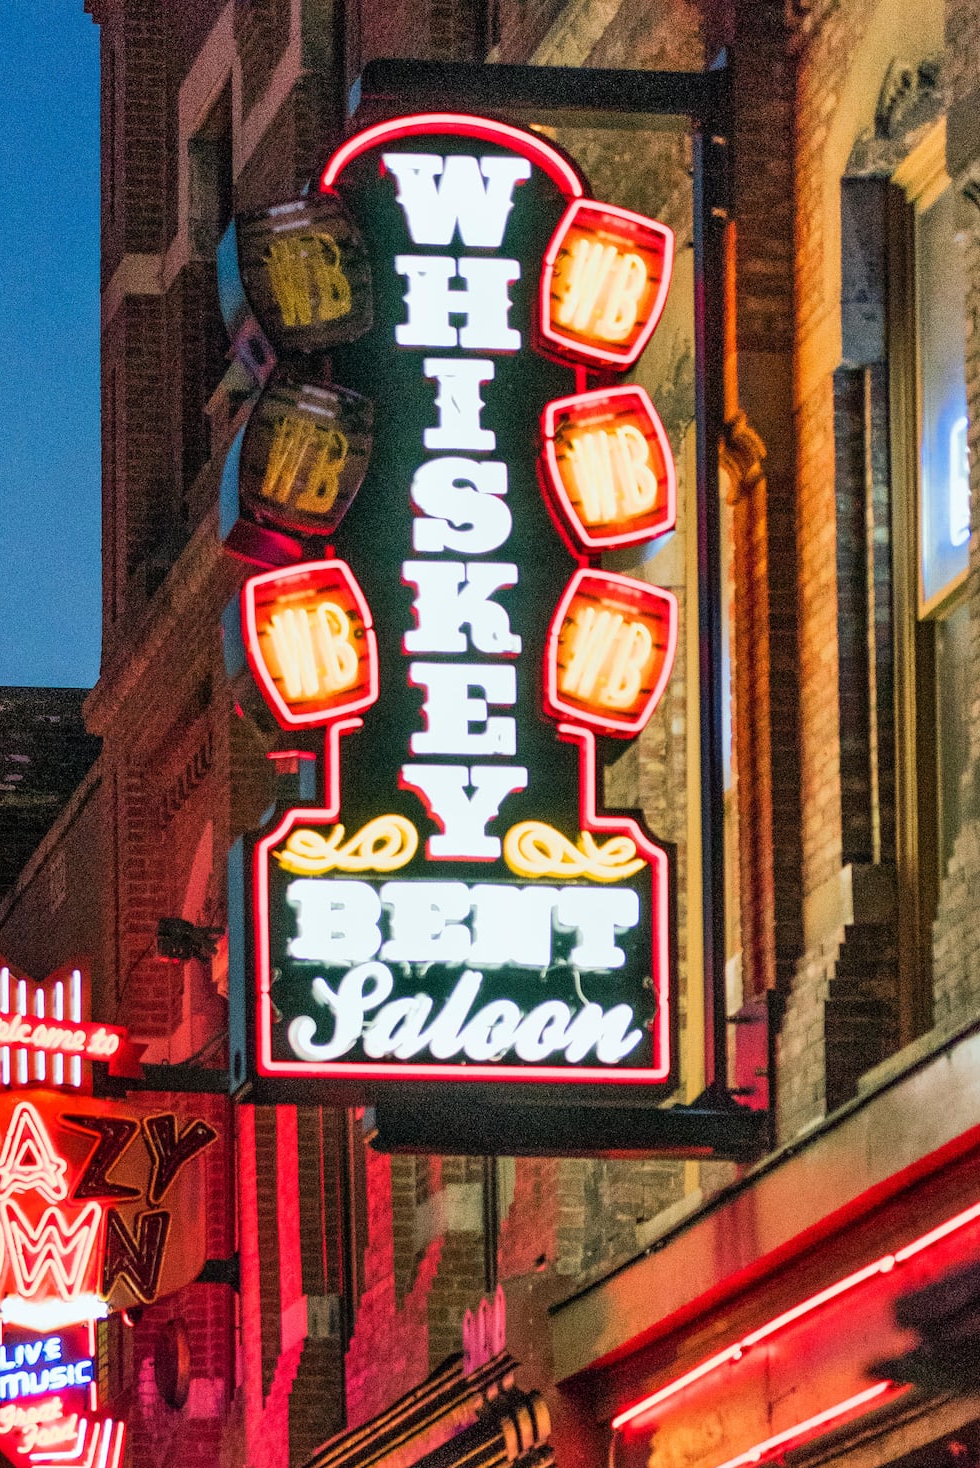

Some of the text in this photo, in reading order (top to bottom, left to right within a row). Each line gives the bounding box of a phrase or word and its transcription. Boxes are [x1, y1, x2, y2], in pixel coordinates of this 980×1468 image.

[381, 153, 532, 859] WHISKEY
[286, 879, 639, 968] BENT
[86, 1027, 120, 1056] to
[288, 961, 643, 1063] Saloon
